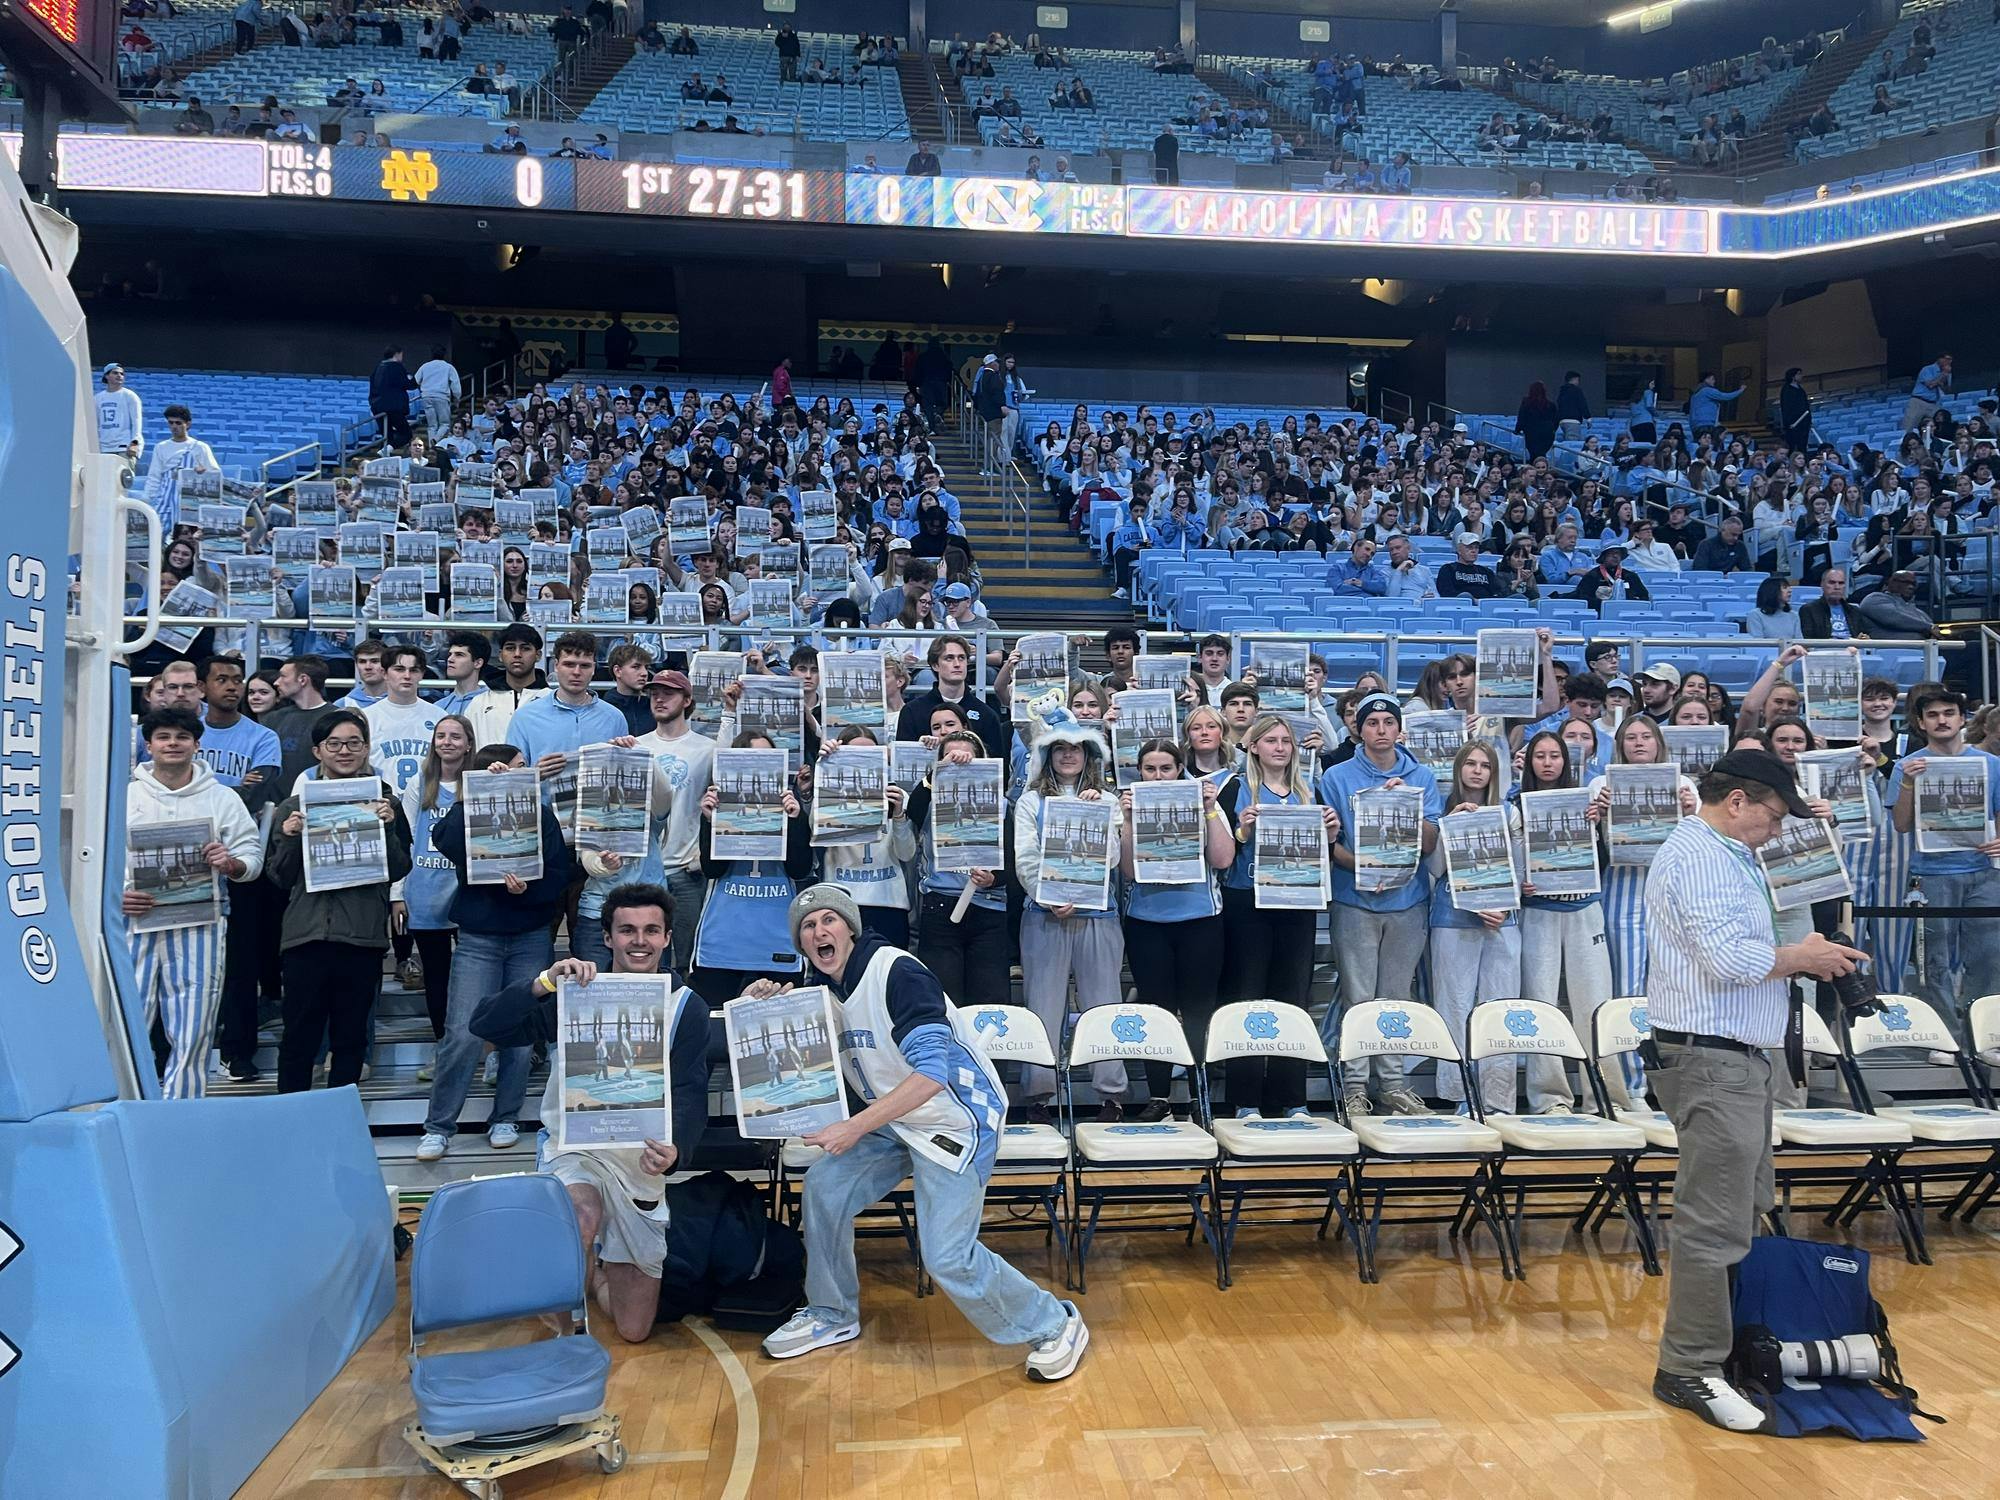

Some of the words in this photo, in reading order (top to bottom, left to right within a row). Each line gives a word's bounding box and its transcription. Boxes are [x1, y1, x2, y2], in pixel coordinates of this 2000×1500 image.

[269, 145, 312, 170] TOL:
[316, 147, 332, 170] 4
[270, 171, 312, 195] FLS:
[315, 172, 332, 196] 0
[516, 157, 543, 207] 0
[622, 163, 673, 209] 1ST
[688, 168, 805, 218] 27:31
[877, 177, 901, 224] 0
[1071, 185, 1109, 207] TOL:
[1111, 188, 1124, 209] 4
[1071, 208, 1107, 230] FLS:
[1111, 212, 1123, 232] 0
[1173, 194, 1381, 240] CAROLINA
[1411, 203, 1667, 248] BASKETBALL
[102, 409, 117, 422] 13
[2, 552, 59, 984] @GOHEELS
[836, 866, 897, 882] CAROLINA
[725, 881, 788, 898] CAROLINA
[1005, 1041, 1034, 1051] CLUB
[1223, 1040, 1245, 1051] THE
[1246, 1042, 1275, 1052] RAMS
[1276, 1041, 1306, 1051] CLUB
[1357, 1040, 1379, 1051] THE
[1379, 1042, 1409, 1051] RAMS
[1409, 1040, 1439, 1050] CLUB
[1487, 1038, 1508, 1048] THE
[1508, 1039, 1536, 1049] RAMS
[1536, 1038, 1566, 1048] CLUB
[1615, 1036, 1633, 1046] THE
[1866, 1033, 1884, 1043] THE
[1885, 1033, 1911, 1043] RAMS
[1911, 1032, 1939, 1041] CLUB
[1090, 1044, 1111, 1055] THE
[1113, 1046, 1142, 1056] RAMS
[1144, 1045, 1174, 1056] CLUB
